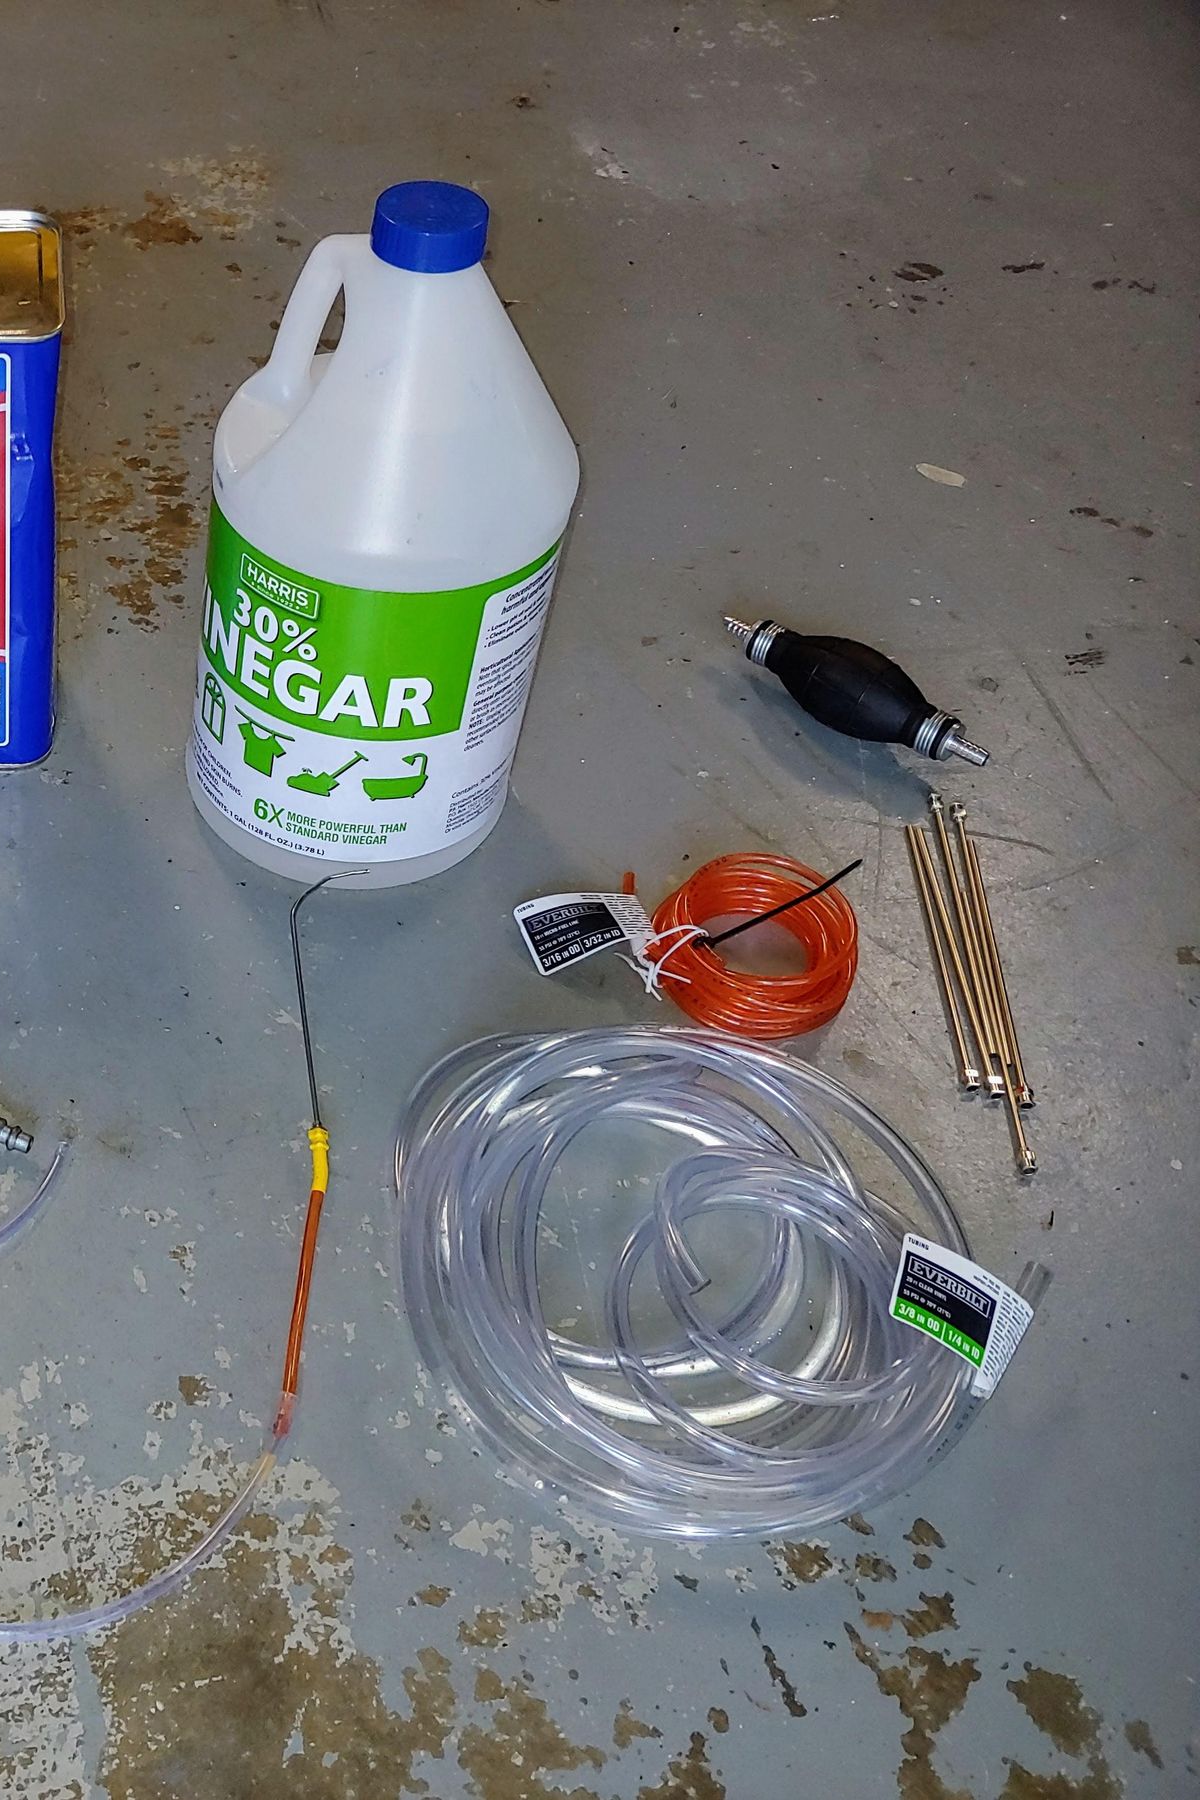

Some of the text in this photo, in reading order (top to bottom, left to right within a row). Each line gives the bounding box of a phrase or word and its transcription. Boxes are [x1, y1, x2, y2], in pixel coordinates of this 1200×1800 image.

[247, 562, 309, 607] HARRIS
[233, 588, 318, 661] 30%
[203, 573, 433, 729] INEGAR
[221, 776, 243, 798] BURNS.
[253, 798, 285, 829] 6X
[286, 811, 408, 834] MORE POWERFUL THAN
[234, 814, 247, 827] GAL
[247, 823, 264, 836] (128
[264, 831, 276, 841] FL.
[277, 837, 293, 848] OZ.)
[294, 843, 315, 854] (3.78
[316, 848, 325, 856] L)
[285, 822, 387, 845] STANDARD VINEGAR
[530, 903, 598, 930] EVERBILT
[583, 929, 621, 948] 3/32 IN ID
[542, 943, 581, 967] 3/16 IN OD
[908, 1237, 929, 1251] TUBING
[912, 1260, 988, 1312] EVERBILT
[918, 1282, 933, 1294] CLEAR
[898, 1303, 940, 1332] 3/8 IN OD
[948, 1330, 980, 1359] 1/4 IN ID
